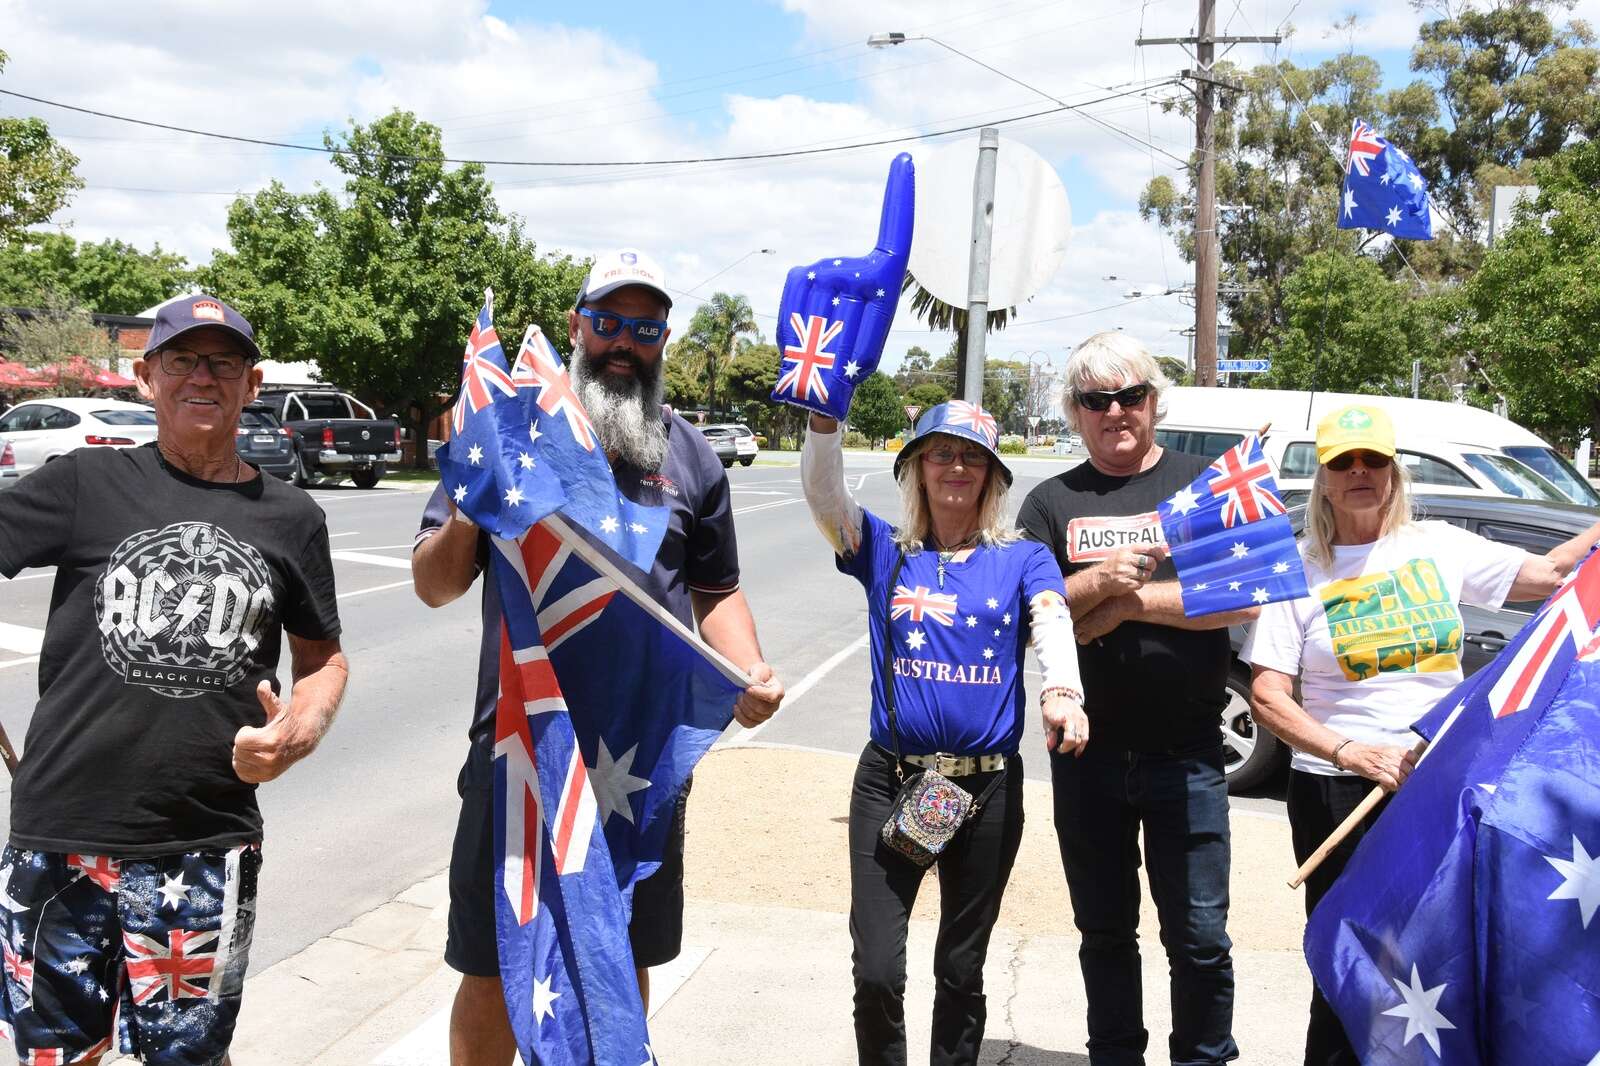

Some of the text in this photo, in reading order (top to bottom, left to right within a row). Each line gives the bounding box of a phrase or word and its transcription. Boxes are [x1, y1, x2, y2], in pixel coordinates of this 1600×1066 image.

[597, 318, 660, 336] I AUS
[1334, 603, 1457, 637] AUSTRALIA
[132, 669, 223, 686] BLACK ICE
